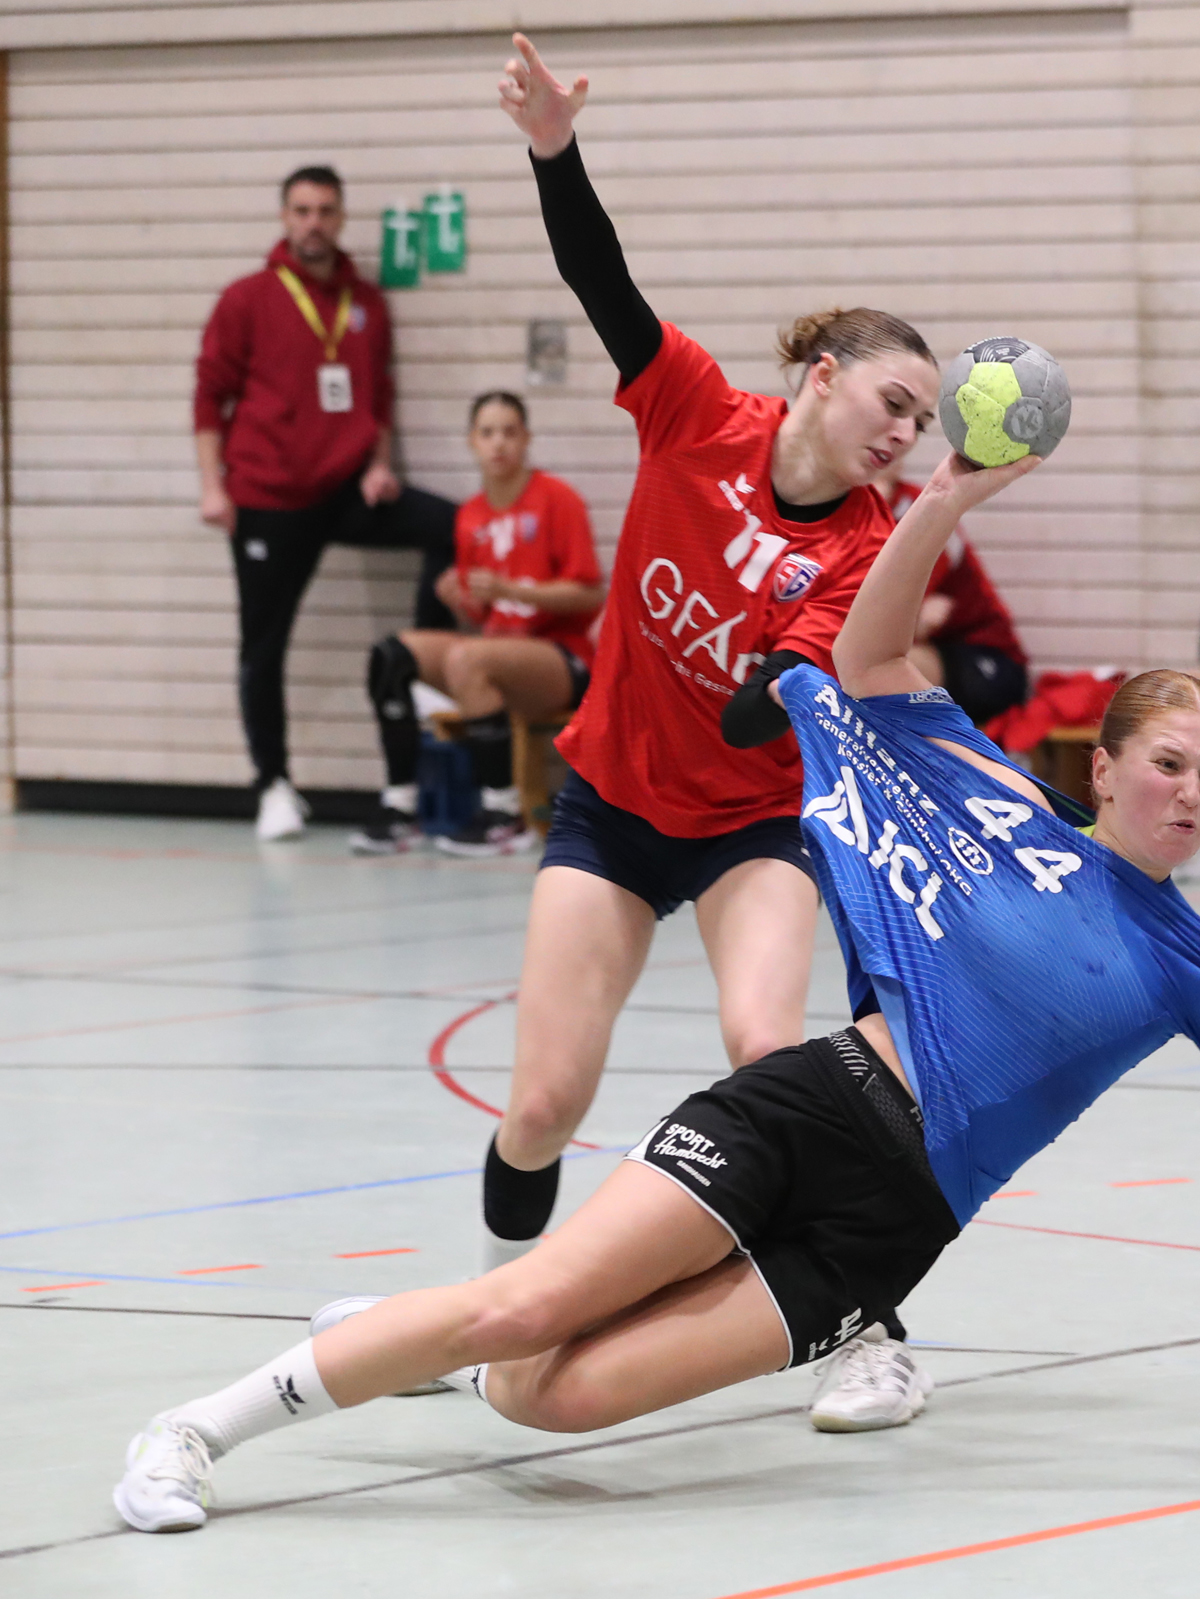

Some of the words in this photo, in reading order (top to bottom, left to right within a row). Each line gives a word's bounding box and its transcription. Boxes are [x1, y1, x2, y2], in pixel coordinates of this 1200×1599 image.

[723, 509, 789, 593] 11
[814, 684, 940, 818] Allianz
[964, 796, 1083, 894] 44
[653, 1134, 728, 1170] Hambrecht
[665, 1123, 715, 1153] SPORT
